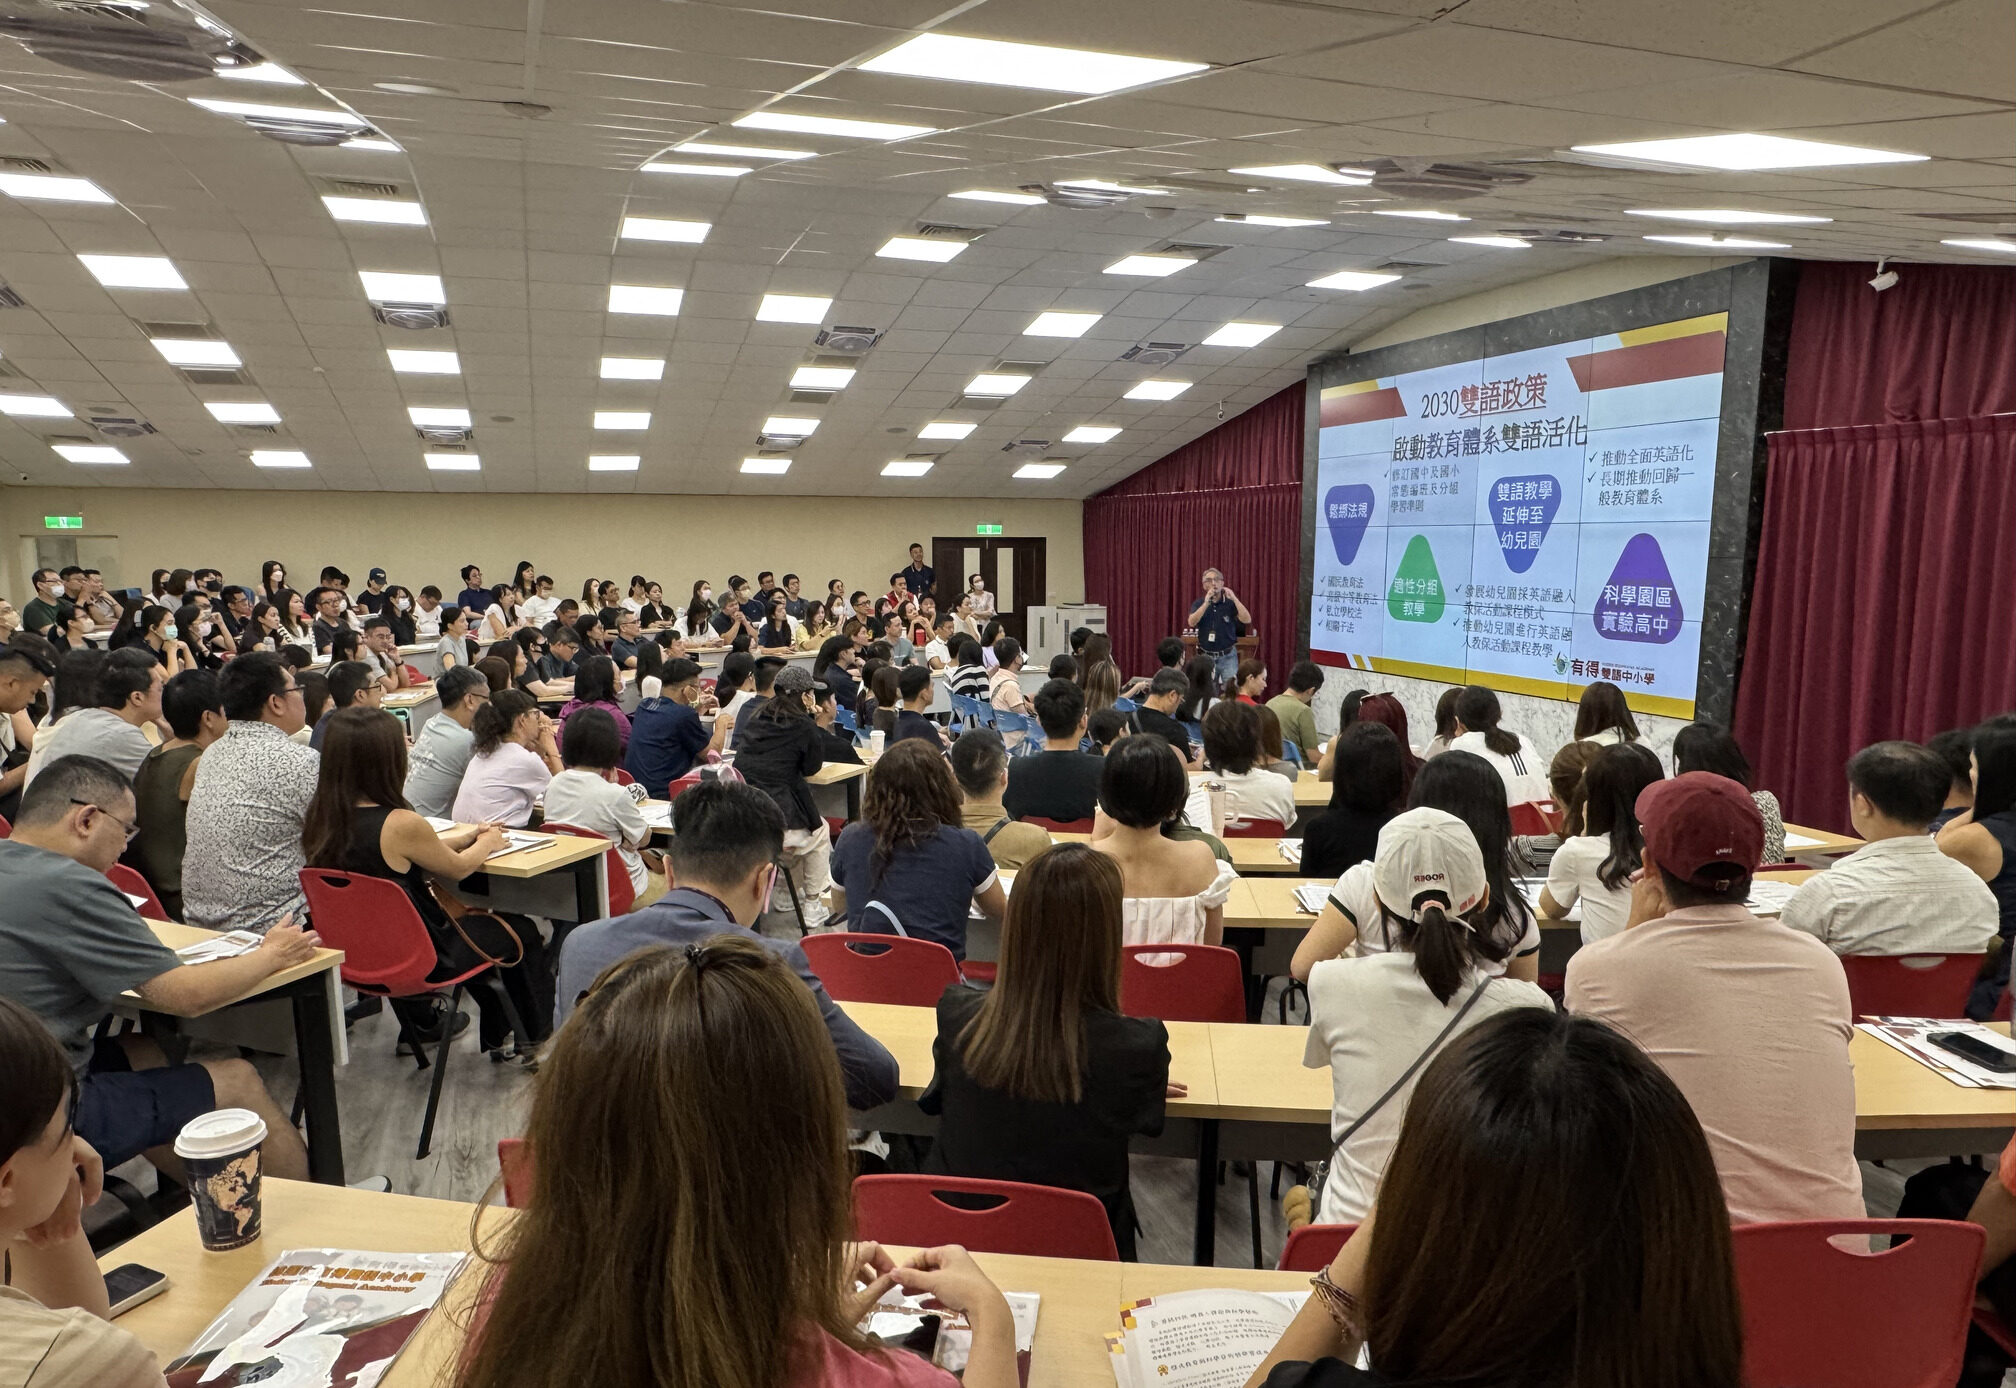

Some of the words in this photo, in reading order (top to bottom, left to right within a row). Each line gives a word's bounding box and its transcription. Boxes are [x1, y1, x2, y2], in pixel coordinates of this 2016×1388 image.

[1421, 373, 1547, 418] 2030雙語政策
[1393, 415, 1587, 461] 啟動教育體系雙語活化
[1601, 444, 1694, 467] 推動全面英語化
[1497, 481, 1552, 502] 雙語教學
[1599, 488, 1662, 506] 般教育體系
[1502, 506, 1544, 524] 延伸至
[1501, 531, 1541, 550] 幼兒園
[1403, 600, 1425, 616] 教學
[1604, 585, 1672, 608] 科學園區
[1601, 611, 1668, 636] 實驗高中
[1571, 658, 1599, 678] 有得
[1601, 667, 1655, 685] 雙語中小學
